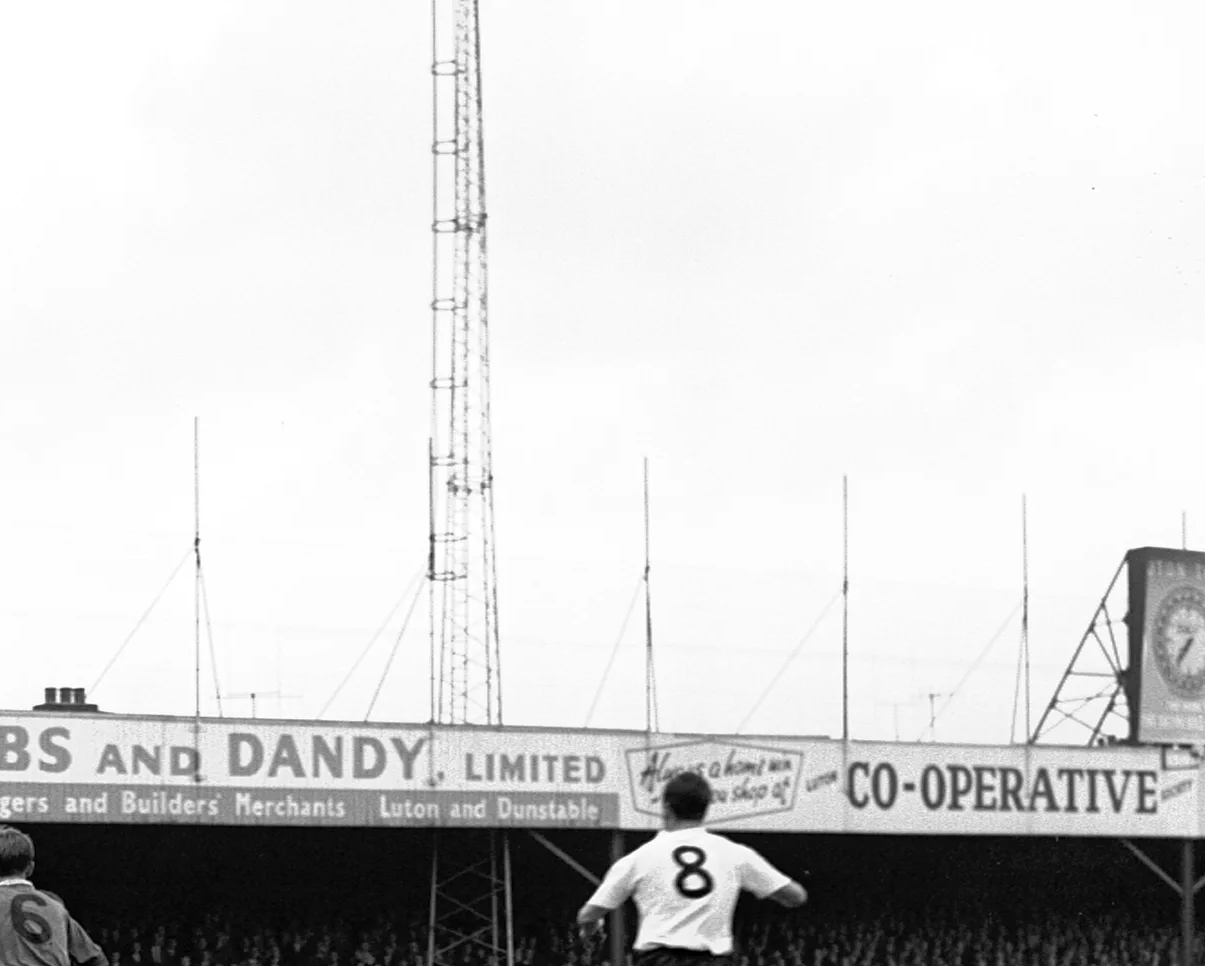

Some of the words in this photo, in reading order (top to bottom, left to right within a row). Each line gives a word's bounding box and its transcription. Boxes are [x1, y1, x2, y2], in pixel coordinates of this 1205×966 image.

[96, 743, 200, 777] AND
[465, 752, 606, 784] LIMITED
[846, 761, 1158, 814] CO-OPERATIVE
[65, 791, 108, 814] and
[235, 792, 346, 818] Merchants
[380, 795, 440, 819] Luton
[450, 797, 486, 819] and
[498, 796, 600, 821] Dunstable
[672, 845, 714, 899] 8
[11, 894, 52, 944] 6
